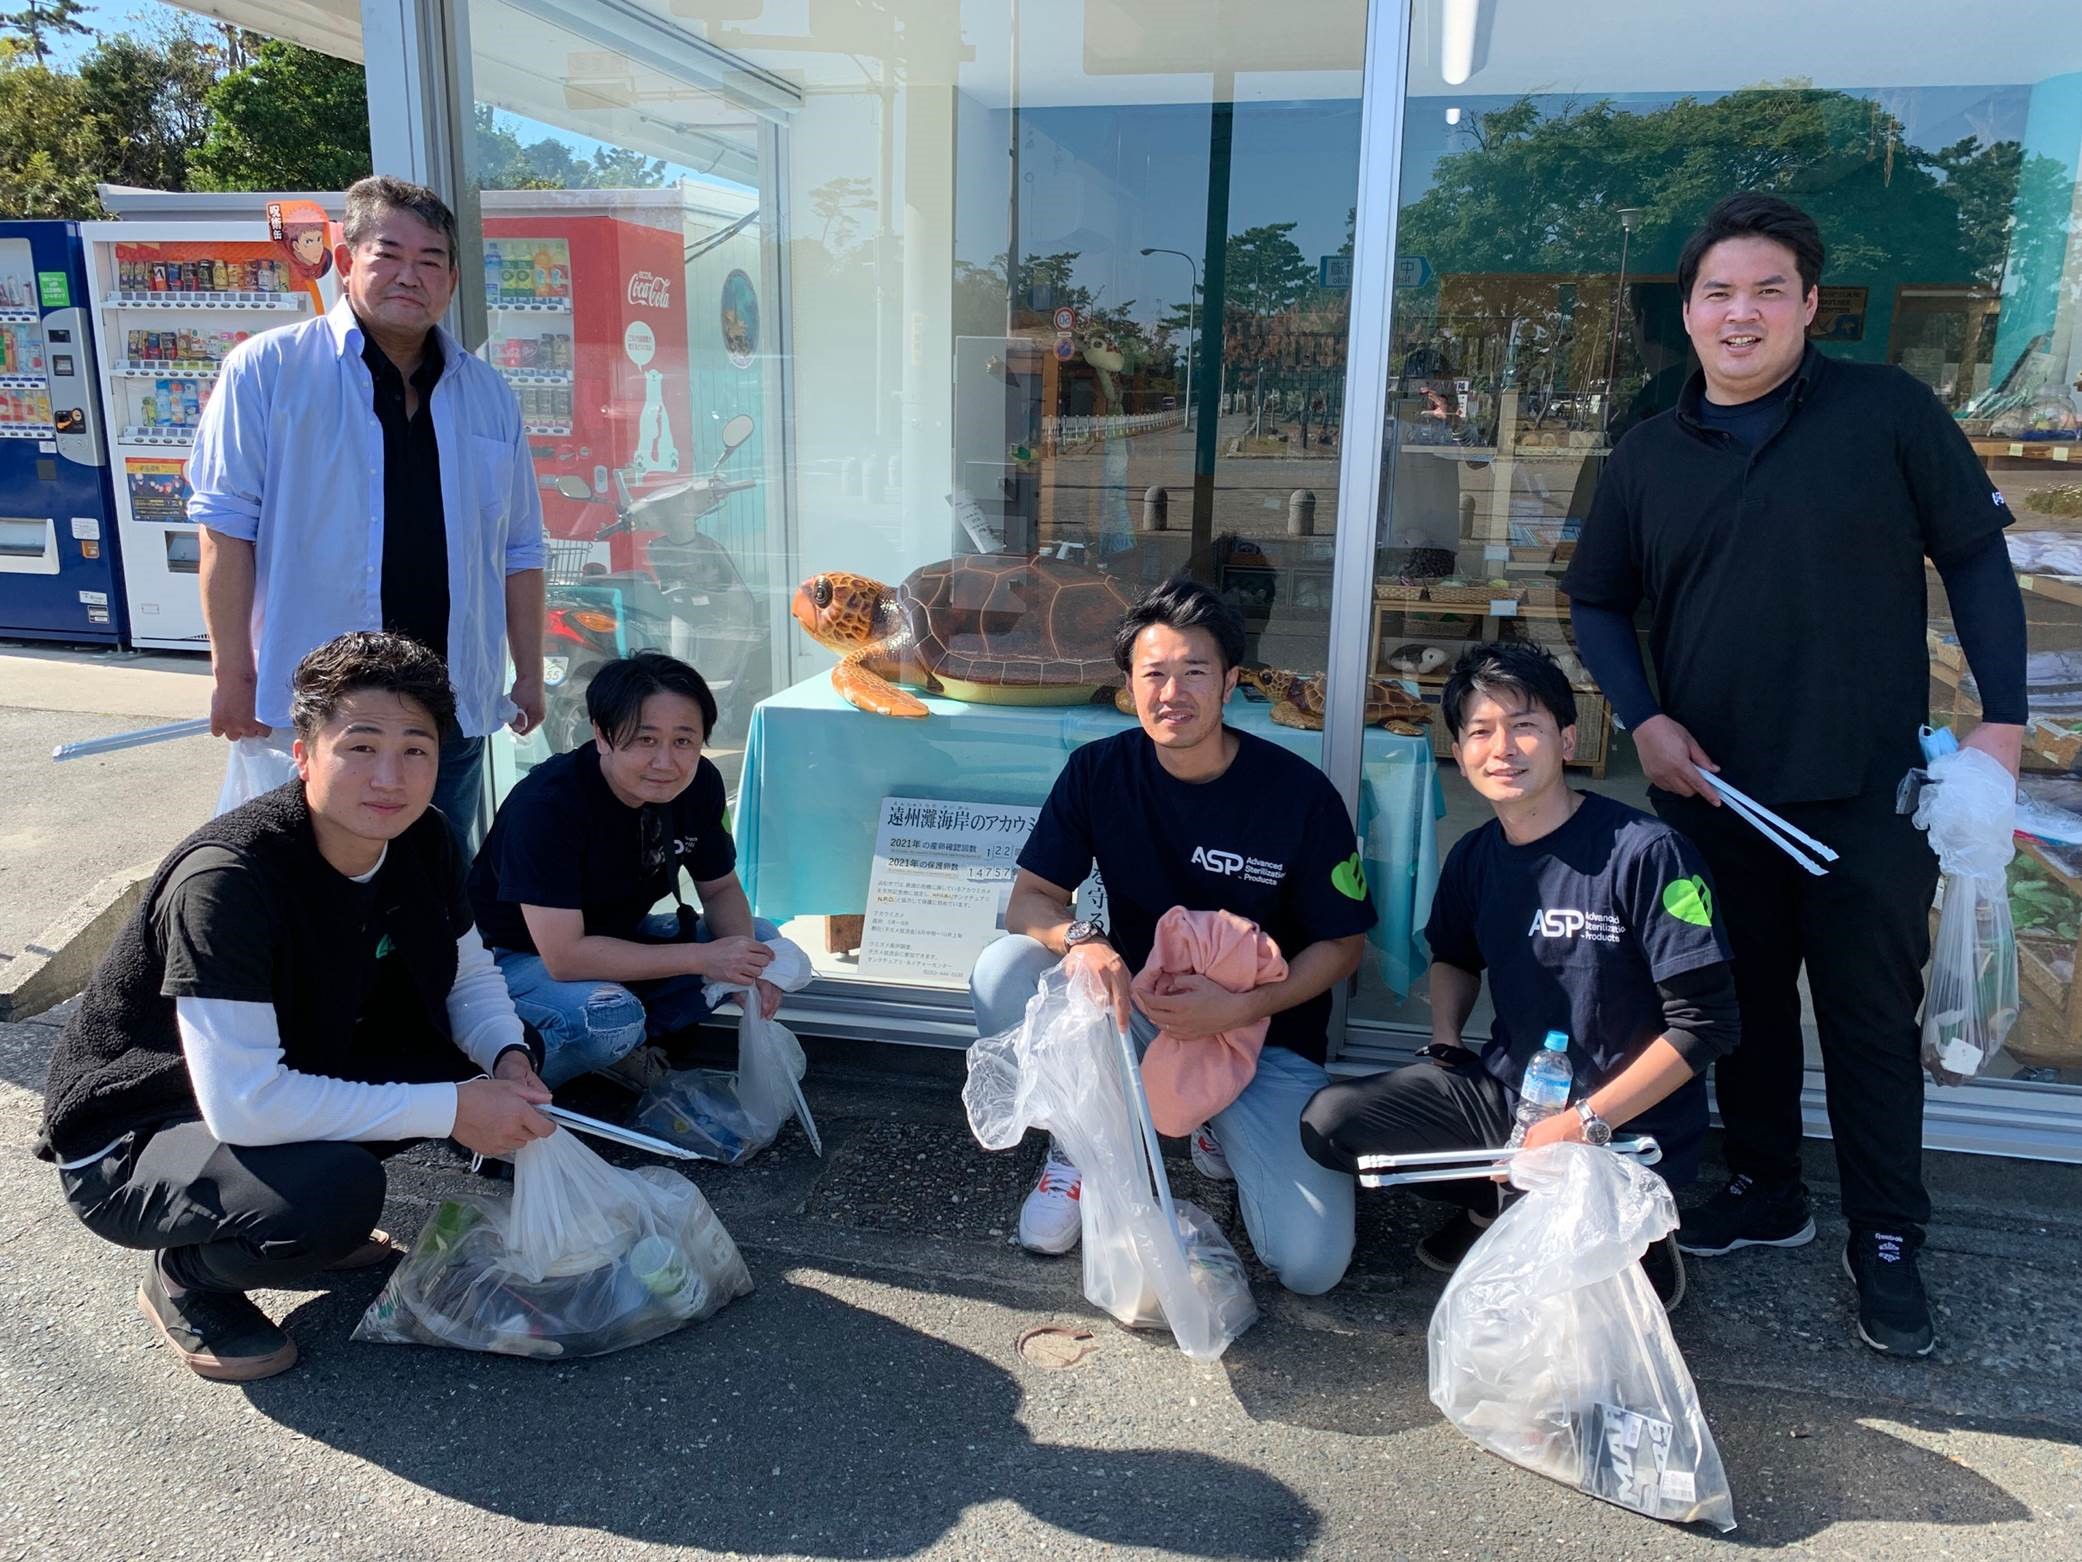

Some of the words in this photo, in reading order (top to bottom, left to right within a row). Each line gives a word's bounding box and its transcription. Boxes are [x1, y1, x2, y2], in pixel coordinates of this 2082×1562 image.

[1191, 846, 1244, 875] ASP
[1246, 857, 1283, 871] Advanced
[1244, 873, 1278, 886] Products
[1528, 909, 1584, 938] ASP
[1585, 921, 1626, 933] Sterilizatio
[1585, 931, 1620, 943] Products
